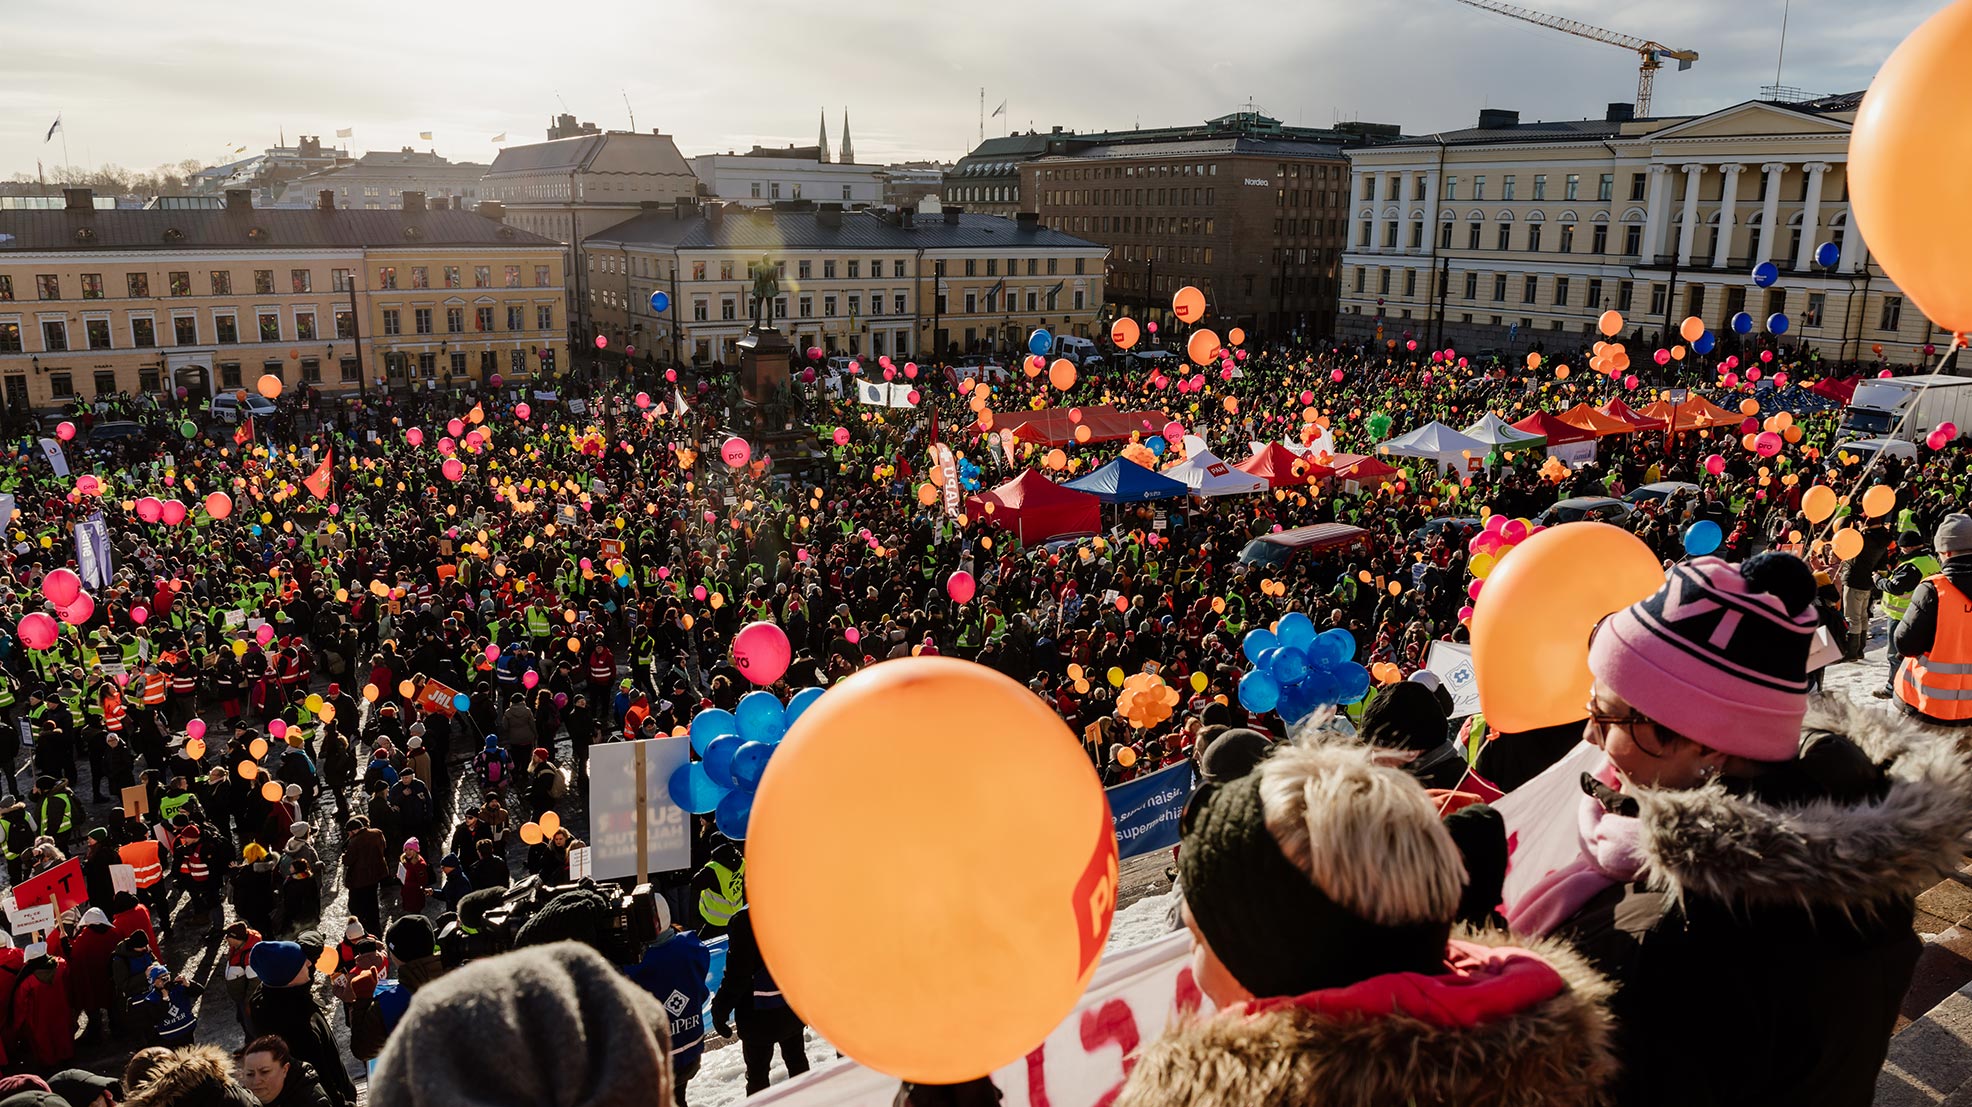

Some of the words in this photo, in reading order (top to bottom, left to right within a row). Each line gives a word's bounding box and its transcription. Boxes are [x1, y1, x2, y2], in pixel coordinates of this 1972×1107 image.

[1244, 178, 1269, 187] Nordea
[1758, 442, 1773, 450] pro
[728, 453, 744, 461] pro
[1210, 464, 1226, 475] PAM
[428, 690, 452, 709] JHL
